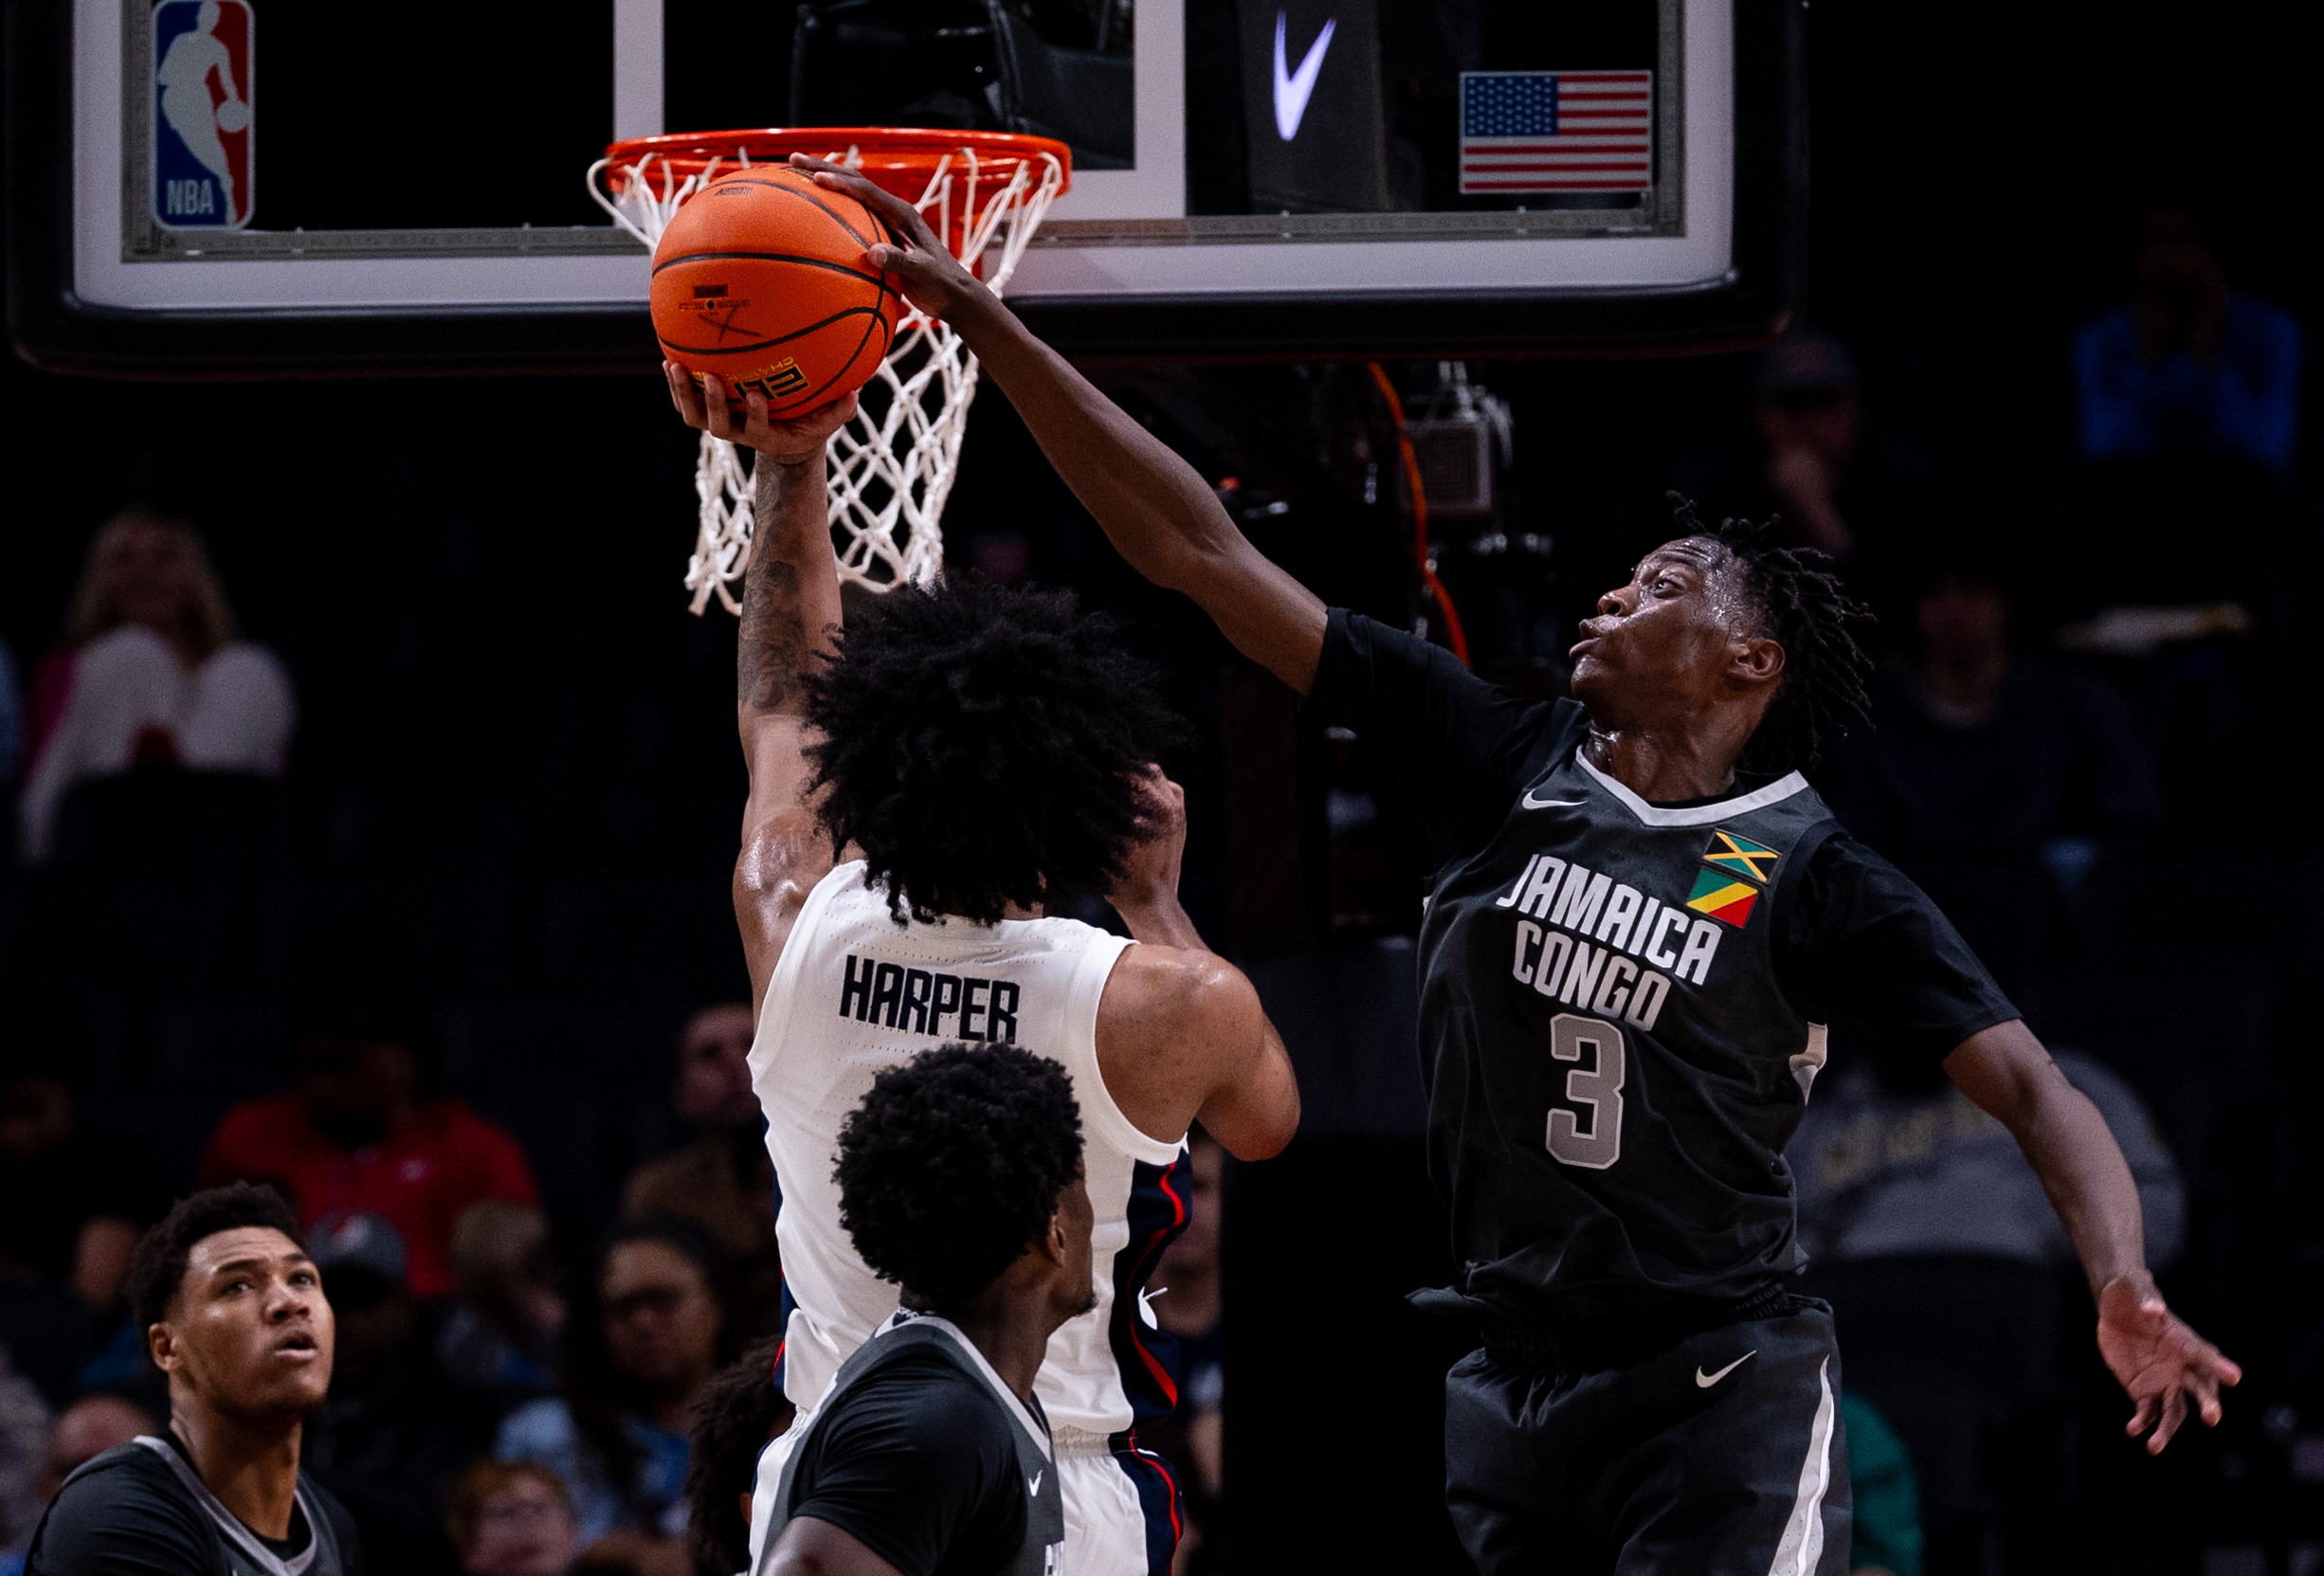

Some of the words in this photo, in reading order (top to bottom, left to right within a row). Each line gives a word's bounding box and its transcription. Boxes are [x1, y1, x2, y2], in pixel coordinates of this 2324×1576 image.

[166, 178, 215, 215] NBA
[1495, 853, 1724, 987] JAMAICA
[1512, 919, 1672, 1032] CONGO
[839, 953, 1021, 1045] HARPER
[1545, 1012, 1626, 1170] 3
